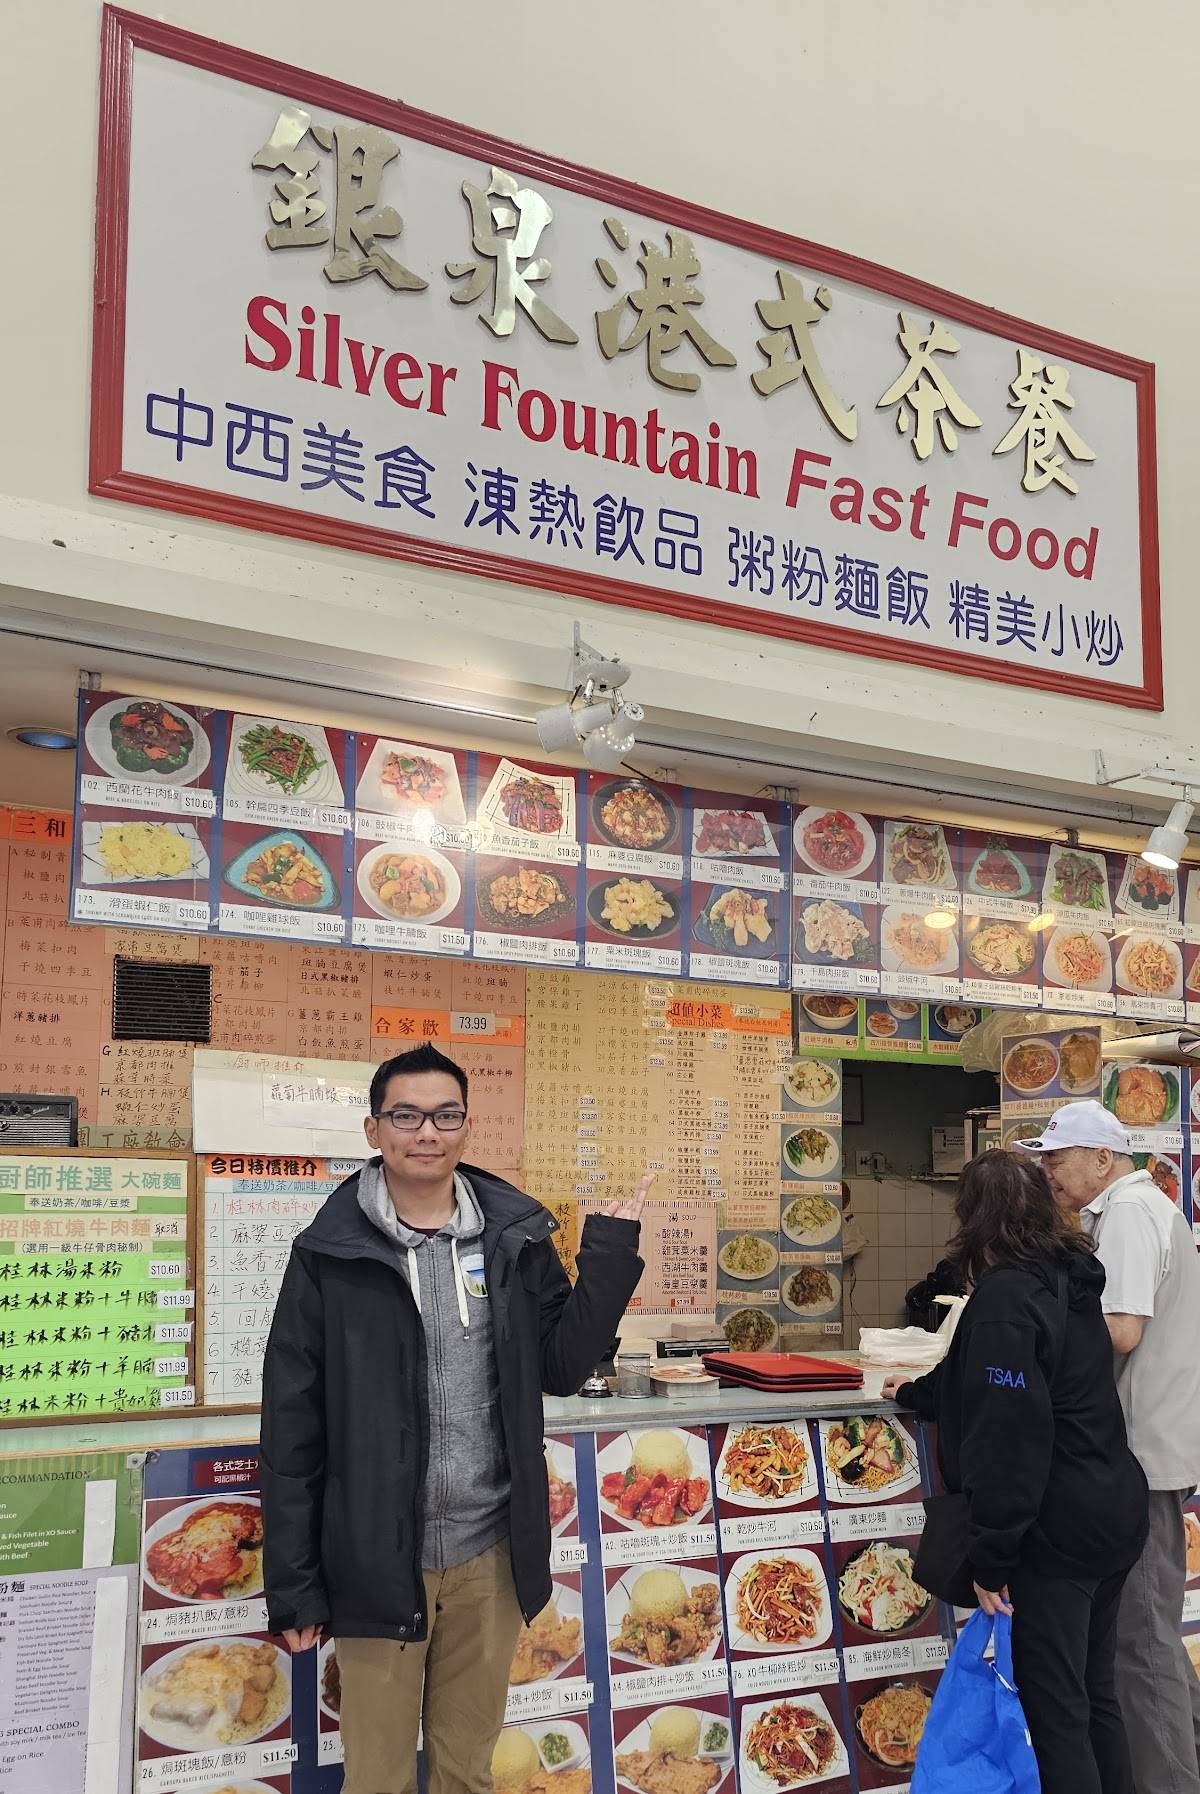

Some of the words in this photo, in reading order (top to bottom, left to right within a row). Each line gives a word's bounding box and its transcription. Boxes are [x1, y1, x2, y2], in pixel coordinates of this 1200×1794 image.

[252, 106, 1096, 494] 銀泉港式茶餐
[245, 295, 458, 417] Silver
[480, 359, 761, 499] Fountain
[785, 447, 929, 541] Fast
[947, 491, 1100, 580] Food
[146, 387, 436, 519] 中西美食
[727, 527, 931, 630] 粥粉麵飯
[948, 580, 1124, 666] 精美小炒
[185, 797, 213, 810] $10.60
[322, 813, 348, 825] $10.60
[557, 846, 580, 858] $10.60
[658, 860, 680, 871] $10.60
[109, 897, 171, 913] 滑蛋蝦仁飯
[179, 907, 207, 919] $10.60
[317, 922, 343, 932] $10.60
[442, 934, 465, 945] $11.50
[553, 947, 576, 957] $10.60
[658, 956, 679, 966] $10.60
[758, 963, 777, 974] $10.60
[859, 974, 878, 983] $10.60
[375, 1017, 439, 1036] 合家歡
[459, 1016, 487, 1030] 73.99
[1164, 1135, 1183, 1144] $10.60
[211, 1157, 317, 1177] 今日特價推介
[121, 1170, 182, 1190] 大碗麵
[0, 1217, 150, 1238] 招牌紅燒牛肉麵
[662, 1228, 690, 1239] 酸辣湯
[151, 1264, 180, 1275] $10.60
[662, 1262, 708, 1273] 西湖牛肉羹
[163, 1295, 191, 1306] $11.99
[161, 1327, 189, 1338] $11.50
[158, 1361, 186, 1373] $11.99
[985, 1367, 1026, 1389] TSAA
[165, 1390, 193, 1402] $11.50
[213, 1458, 259, 1472] 各式芝士
[0, 1471, 91, 1485] COMMANDATION
[906, 1515, 927, 1527] $11.50
[8, 1532, 22, 1540] Fish
[691, 1533, 715, 1544] $11.50
[12, 1540, 50, 1550] Vegetable
[11, 1552, 29, 1560] Beef
[560, 1549, 585, 1562] $11.50
[147, 1618, 161, 1629] 24.
[925, 1645, 947, 1658] $11.50
[814, 1660, 839, 1673] $11.50
[702, 1667, 727, 1680] $11.50
[563, 1690, 592, 1703] $11.50
[6, 1725, 43, 1737] SPECIAL
[46, 1720, 80, 1731] COMBO
[263, 1748, 296, 1763] $11.50
[142, 1767, 156, 1779] 26.
